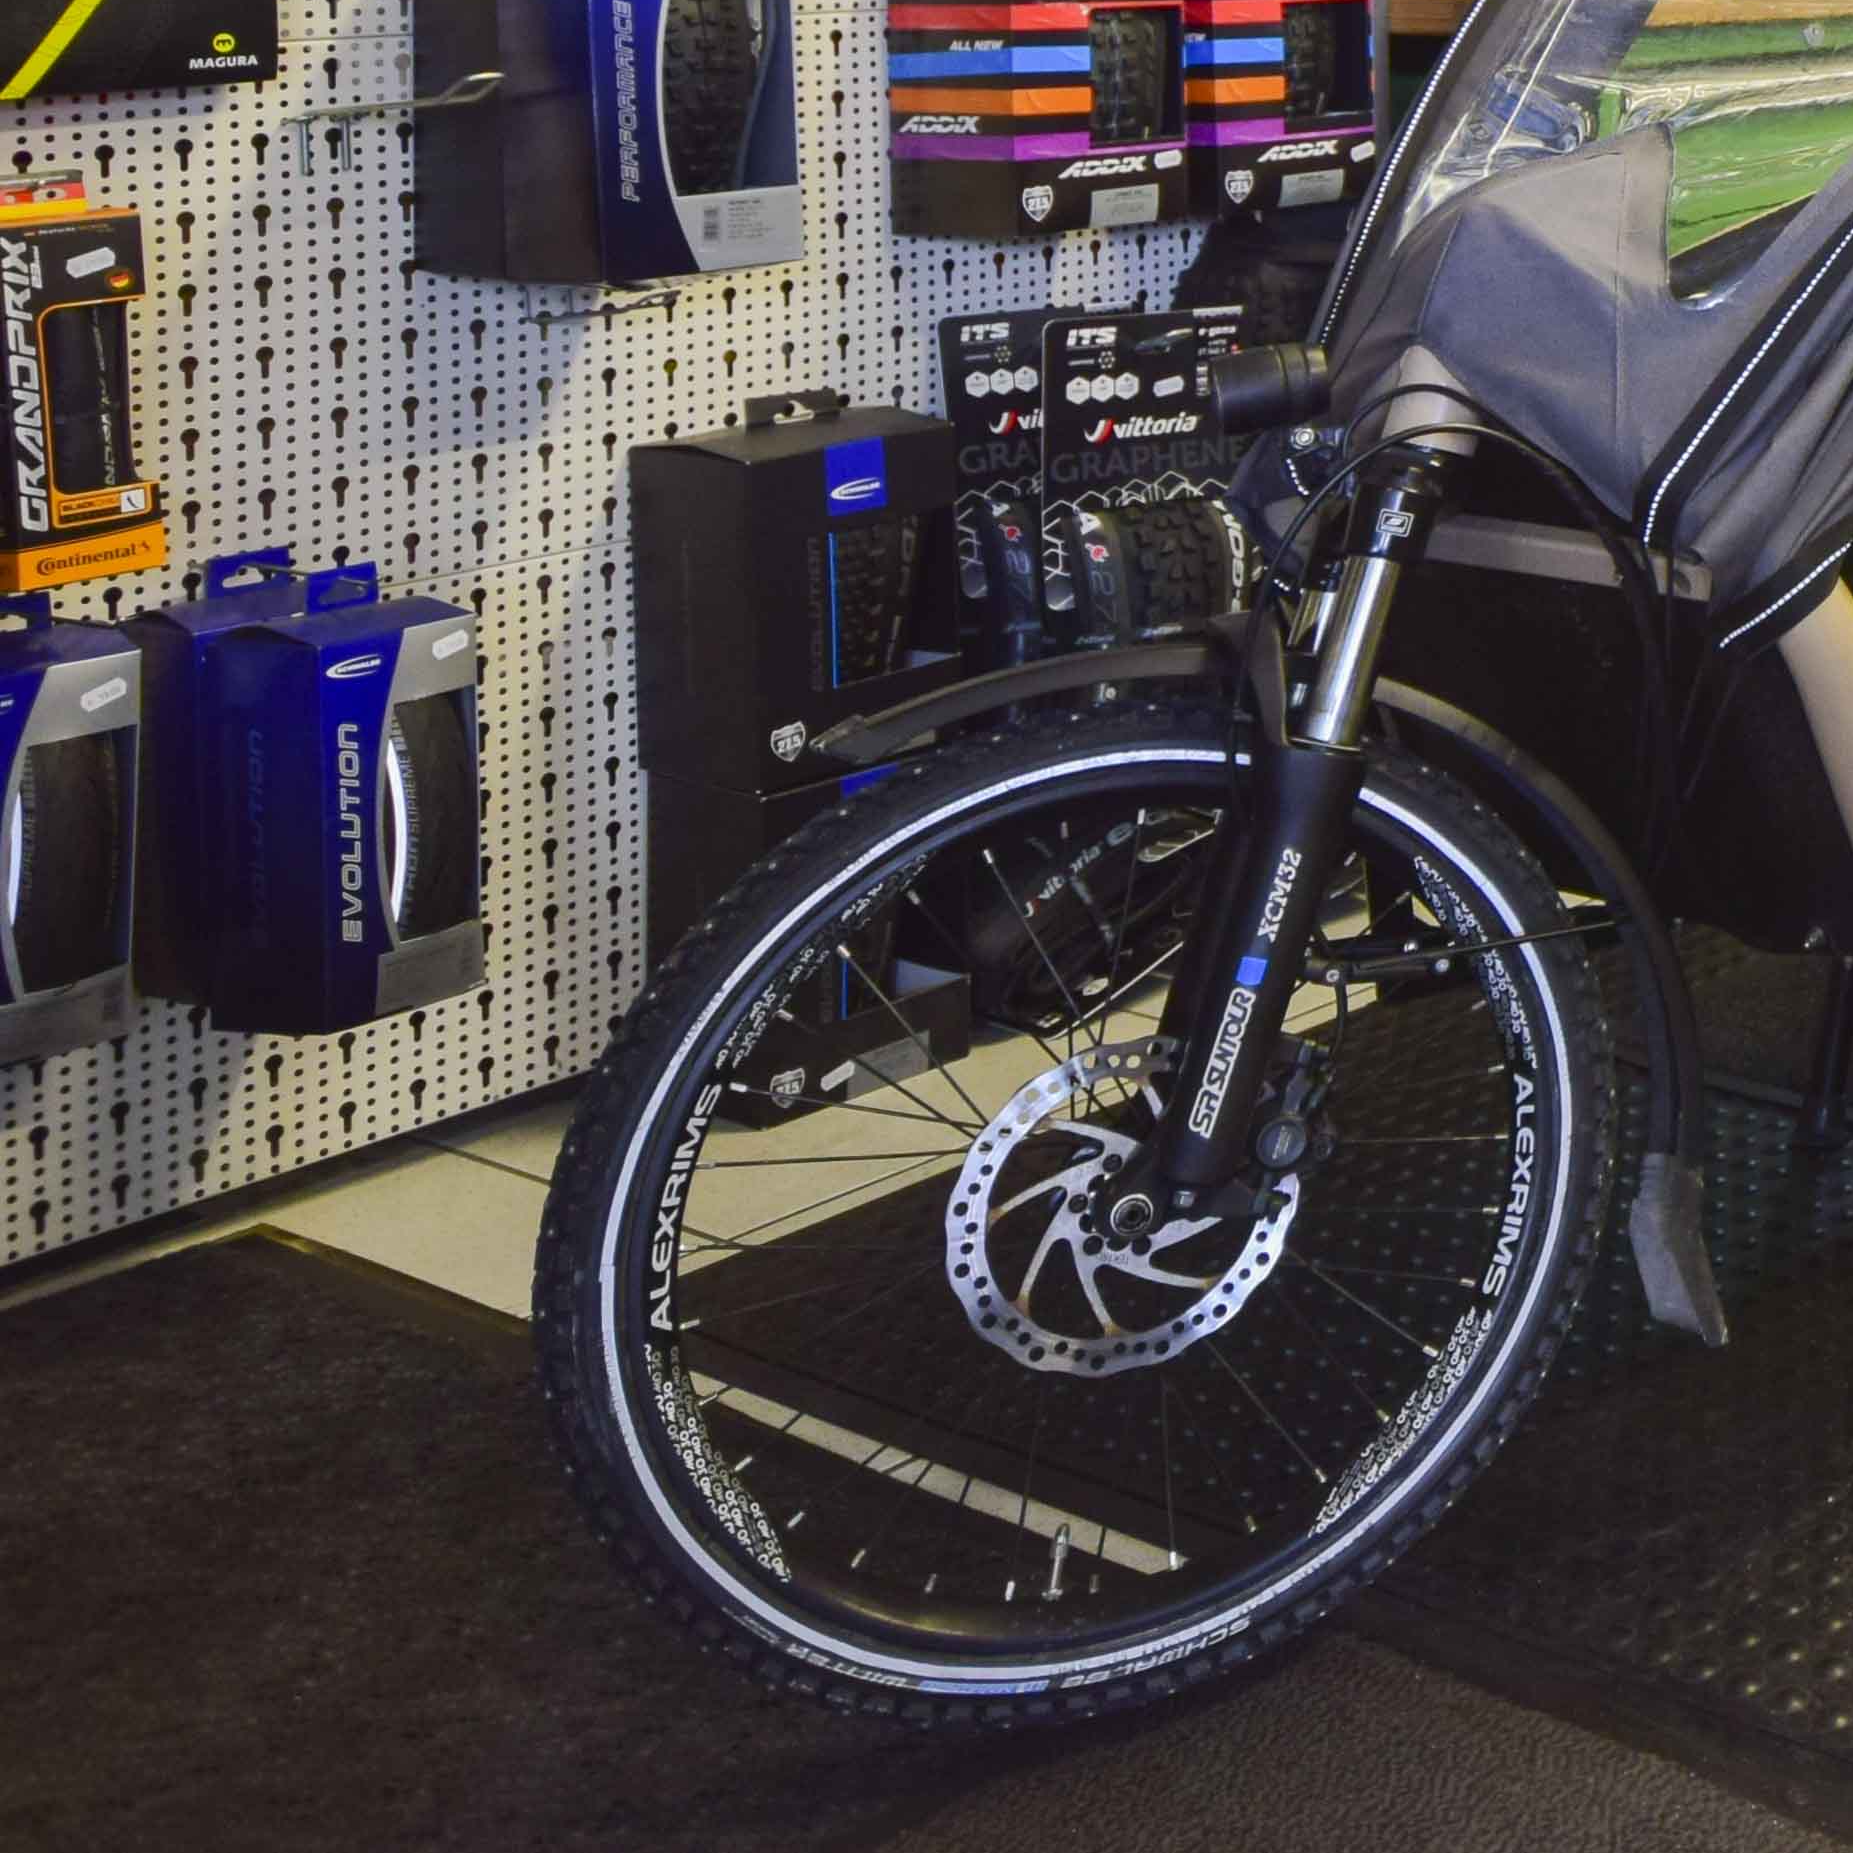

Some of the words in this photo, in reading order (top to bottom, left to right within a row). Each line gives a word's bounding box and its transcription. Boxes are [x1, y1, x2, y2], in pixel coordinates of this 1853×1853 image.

[188, 53, 260, 71] MAGURA
[898, 115, 981, 134] ADDIX
[1057, 154, 1148, 181] ADDIX
[1256, 139, 1340, 164] ADDIX
[960, 321, 1010, 343] ITS
[1066, 326, 1118, 348] ITS
[1112, 409, 1198, 441] vittoria
[1051, 435, 1245, 483] GRAPHENE
[36, 541, 137, 578] Continental
[336, 722, 364, 942] EVOLUTION
[1258, 847, 1302, 943] XCM32
[1481, 1075, 1536, 1298] ALEXRIMS
[649, 1080, 724, 1332] ALEXRIMS
